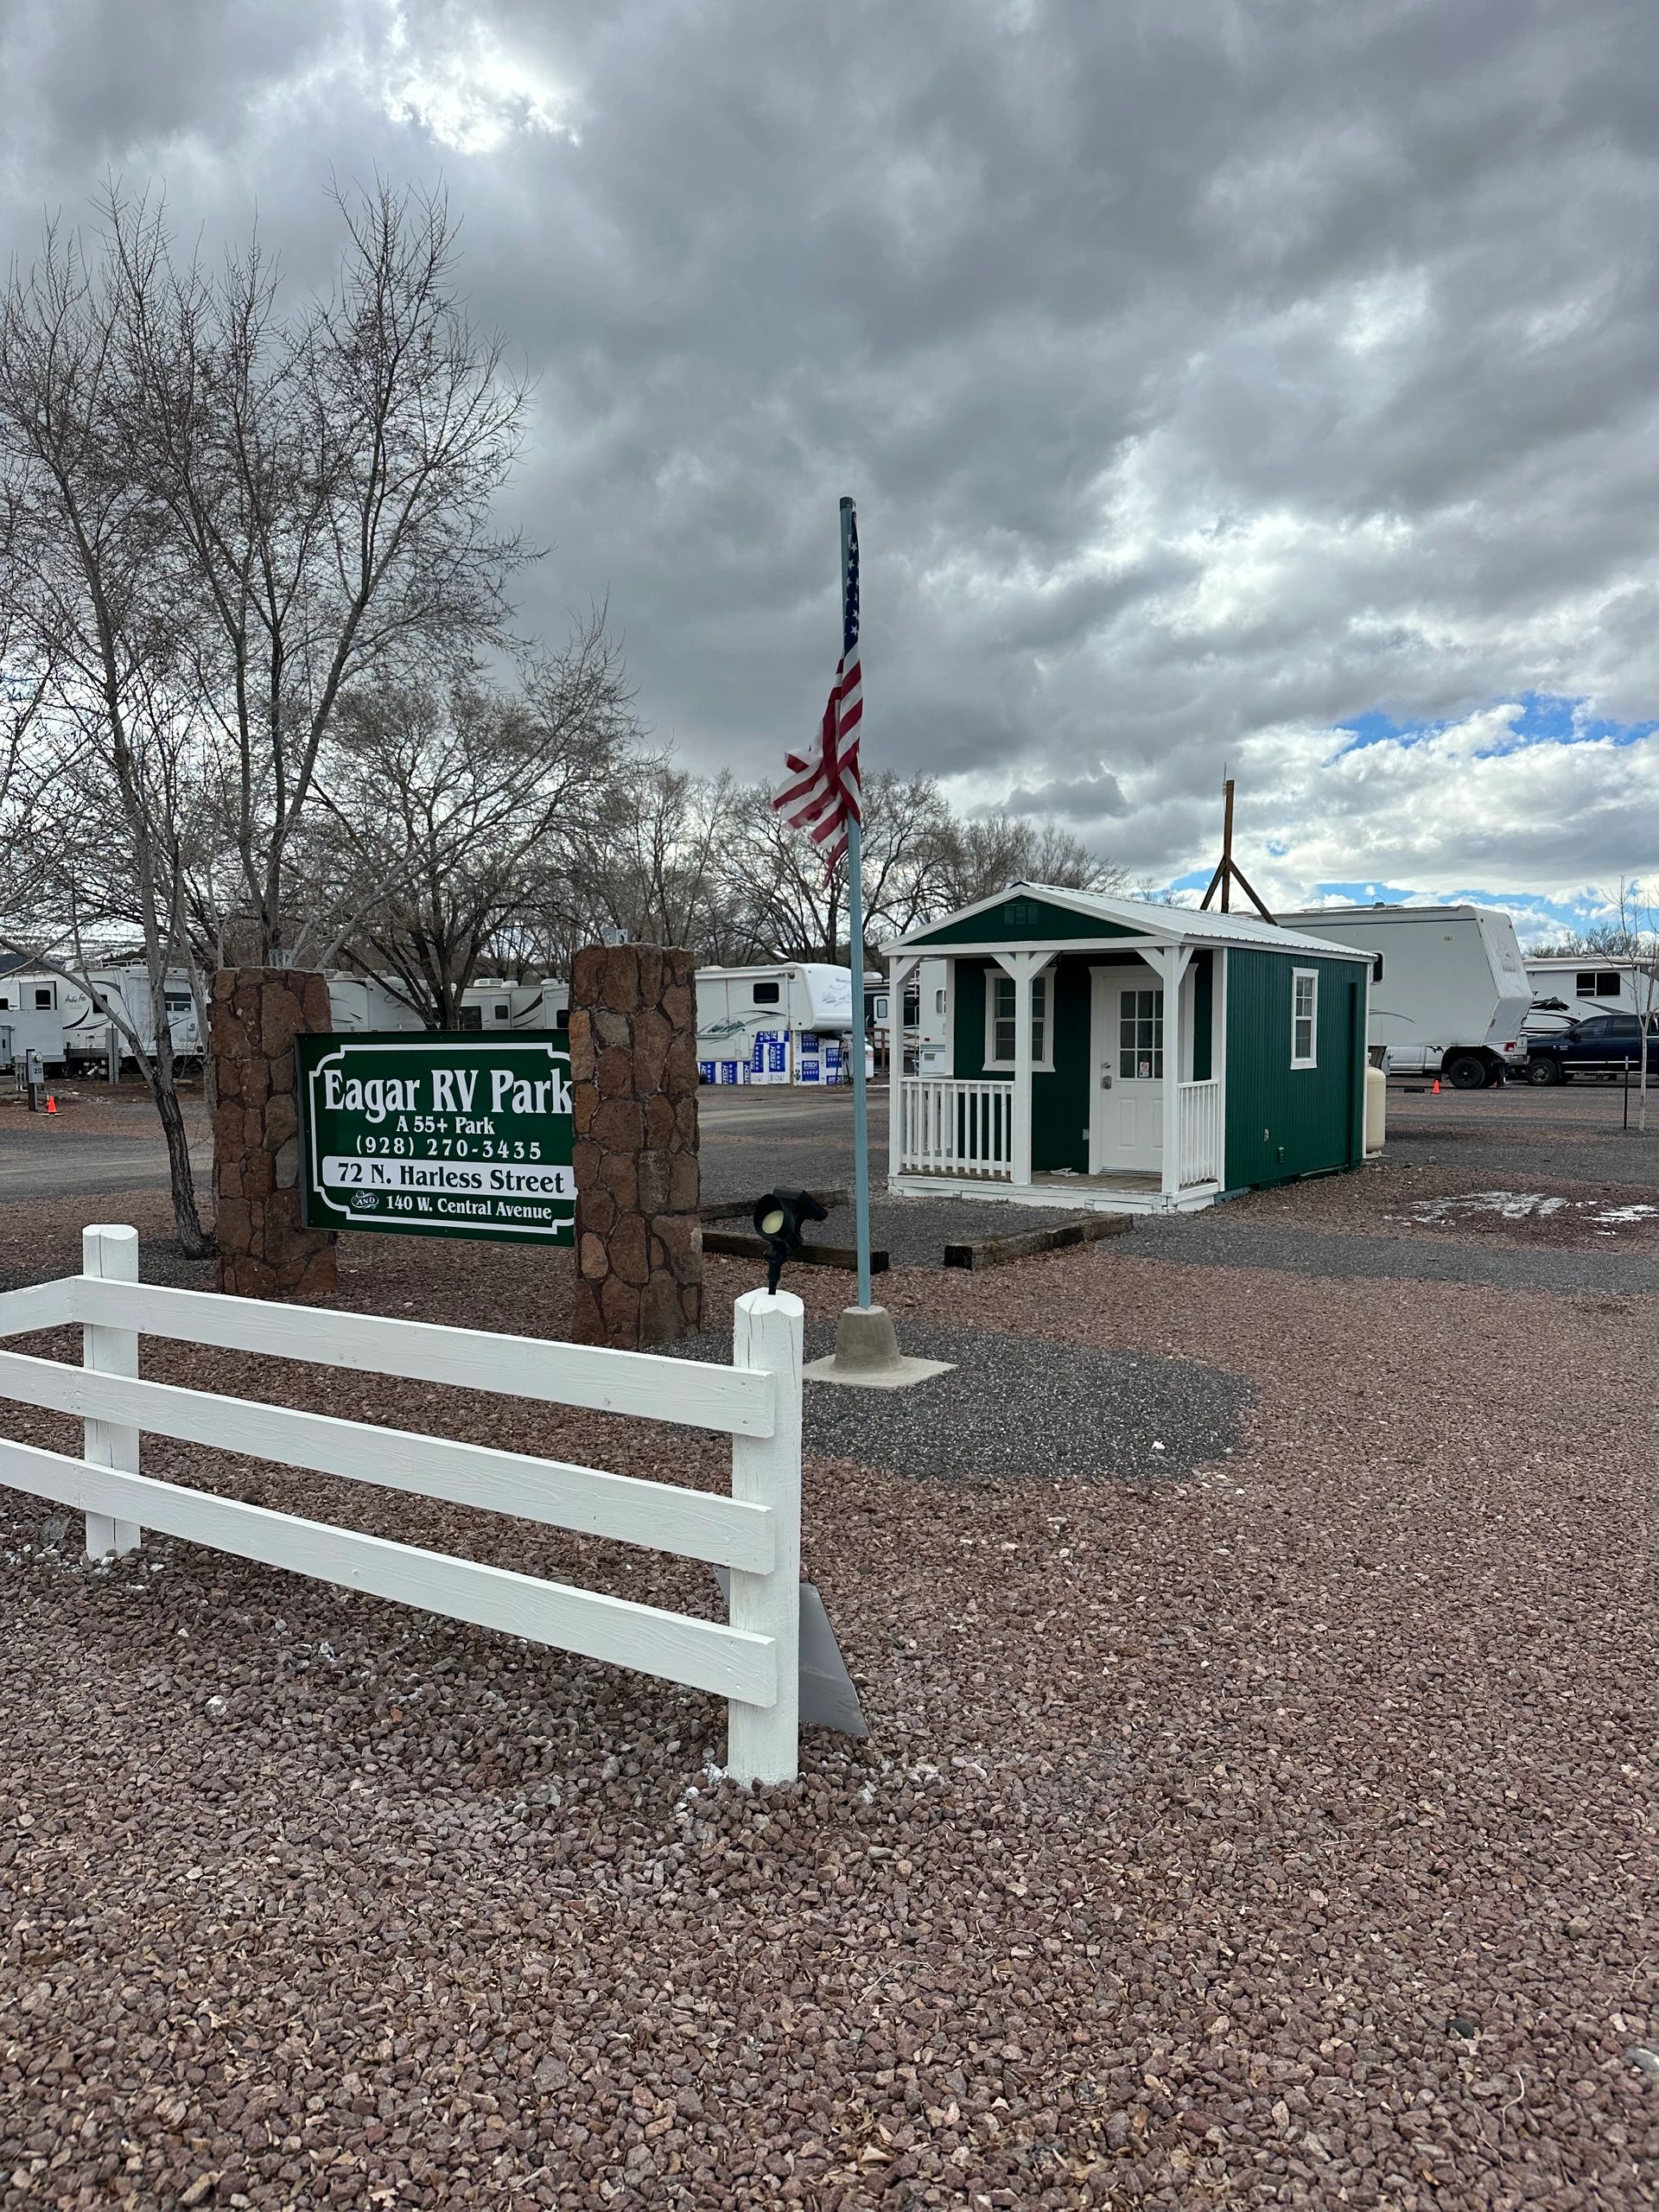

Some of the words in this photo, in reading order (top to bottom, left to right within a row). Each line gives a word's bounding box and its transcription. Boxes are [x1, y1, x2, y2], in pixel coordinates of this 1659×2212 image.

[323, 1069, 421, 1123] Eagar
[430, 1070, 479, 1112] RV
[490, 1067, 573, 1115] Park
[396, 1116, 409, 1132] A
[413, 1116, 448, 1134] 55+
[455, 1116, 495, 1135] Park
[356, 1135, 414, 1156] (928)
[427, 1138, 541, 1160] 270-3435
[338, 1162, 363, 1182] 72
[371, 1163, 391, 1185] N.
[400, 1165, 483, 1189] Harless
[490, 1169, 565, 1193] Street
[356, 1198, 375, 1206] AND
[386, 1194, 413, 1211] 140
[416, 1197, 433, 1211] W.
[437, 1198, 493, 1216] Central
[495, 1201, 552, 1219] Avenue
